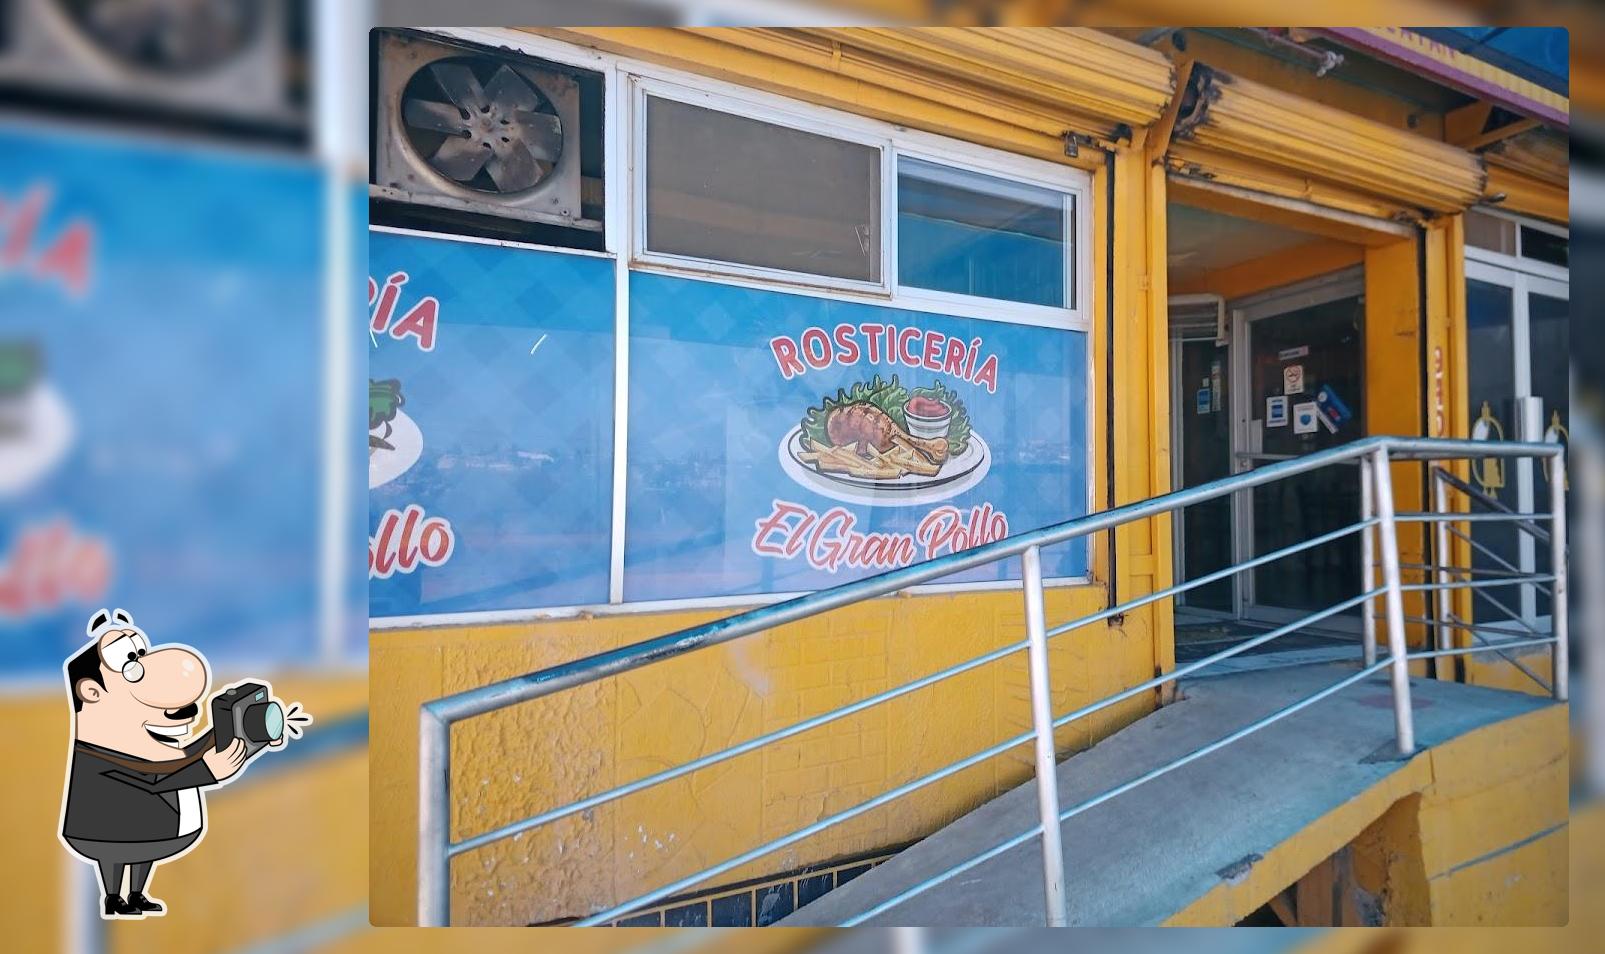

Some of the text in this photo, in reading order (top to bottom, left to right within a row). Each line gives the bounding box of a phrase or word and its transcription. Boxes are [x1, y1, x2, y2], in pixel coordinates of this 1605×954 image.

[369, 272, 439, 351] ÍA
[770, 324, 998, 392] ROSTICERÍA
[753, 500, 1008, 572] El Gran Pollo
